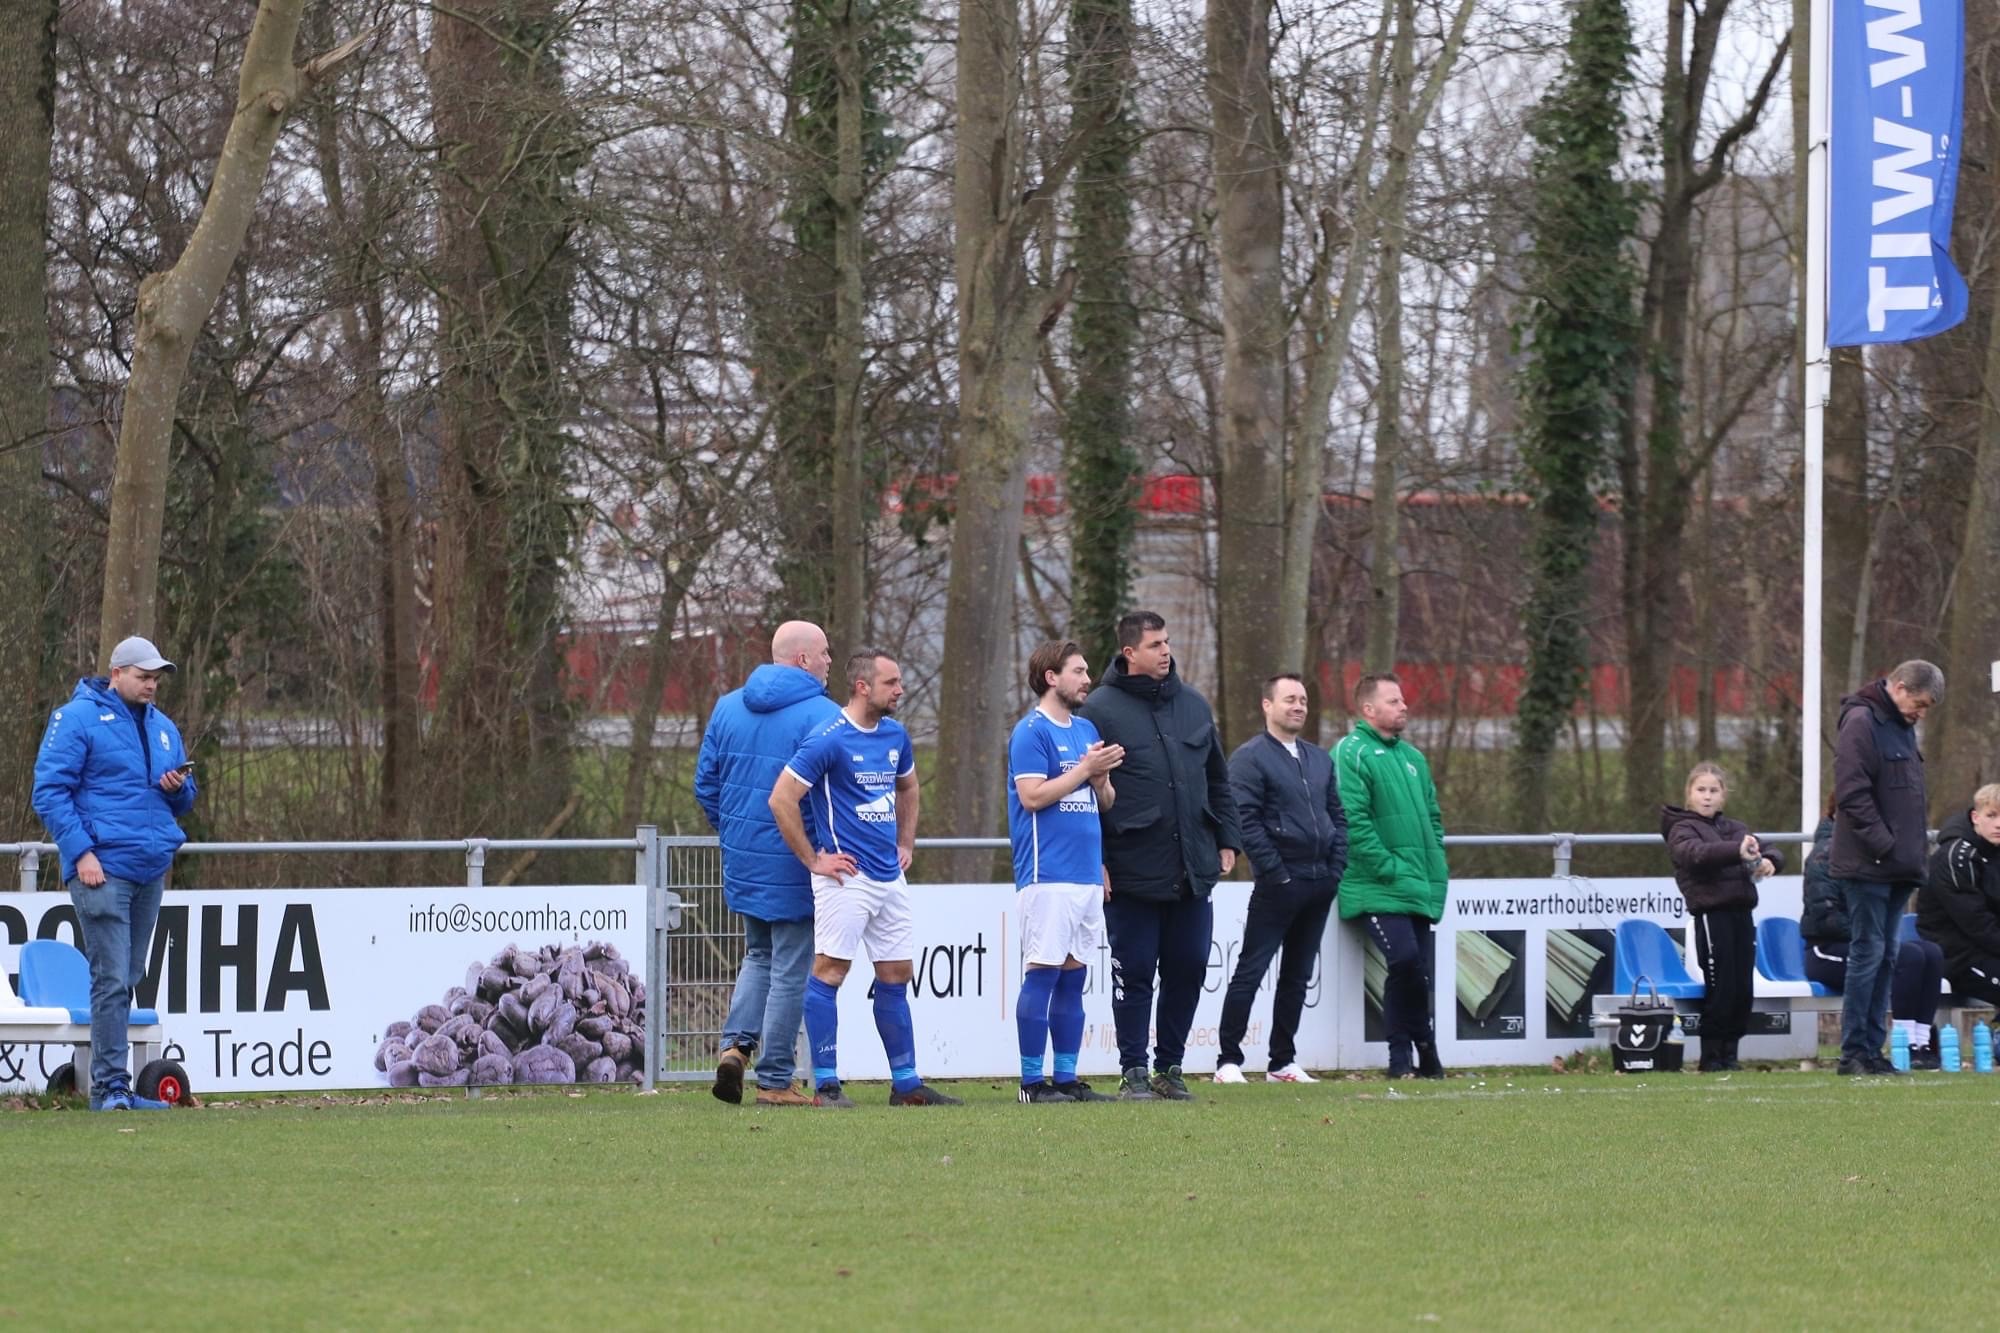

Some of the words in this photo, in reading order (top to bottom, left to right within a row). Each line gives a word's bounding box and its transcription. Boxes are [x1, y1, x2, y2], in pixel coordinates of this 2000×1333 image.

[409, 903, 628, 933] info@socomha.com
[1456, 891, 1688, 919] www.zwarthoutbewerking
[203, 1028, 333, 1078] Trade
